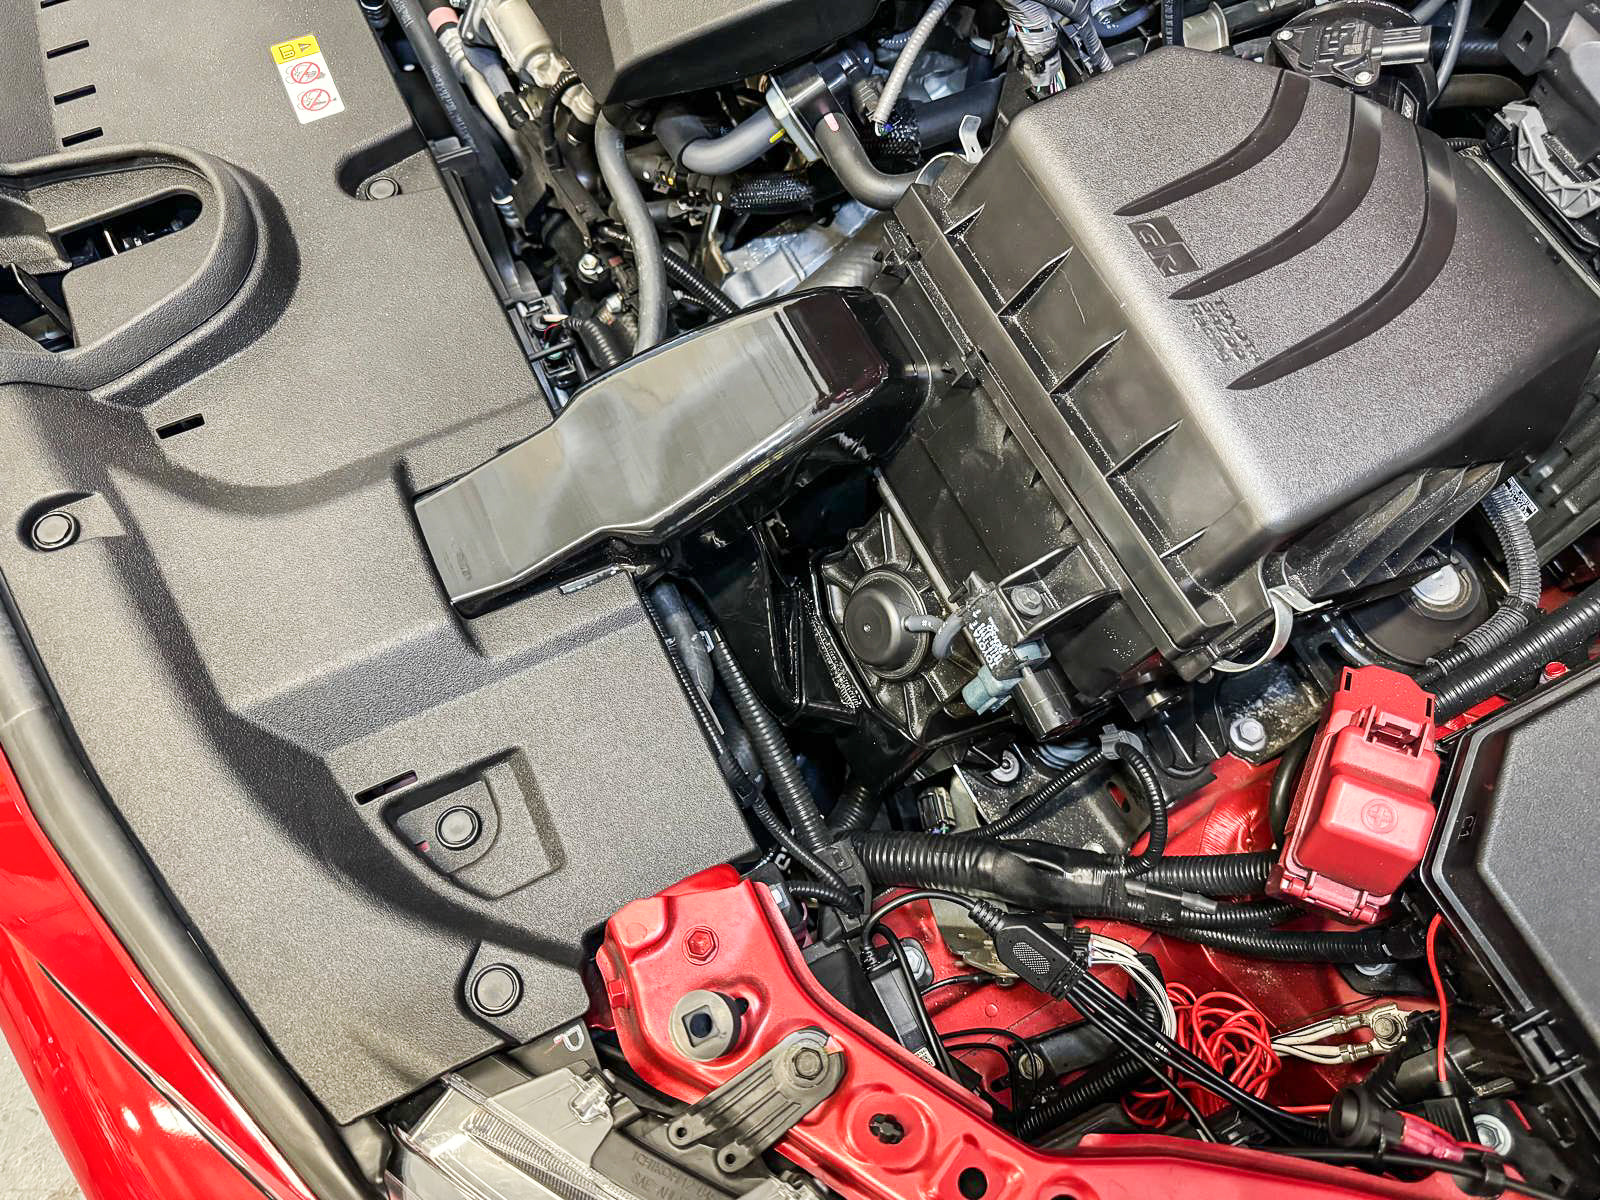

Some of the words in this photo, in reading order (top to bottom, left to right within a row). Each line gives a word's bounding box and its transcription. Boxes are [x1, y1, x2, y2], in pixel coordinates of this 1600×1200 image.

[1128, 219, 1192, 278] GR
[1213, 299, 1265, 362] TOYOTA
[972, 628, 996, 669] TOYOTA
